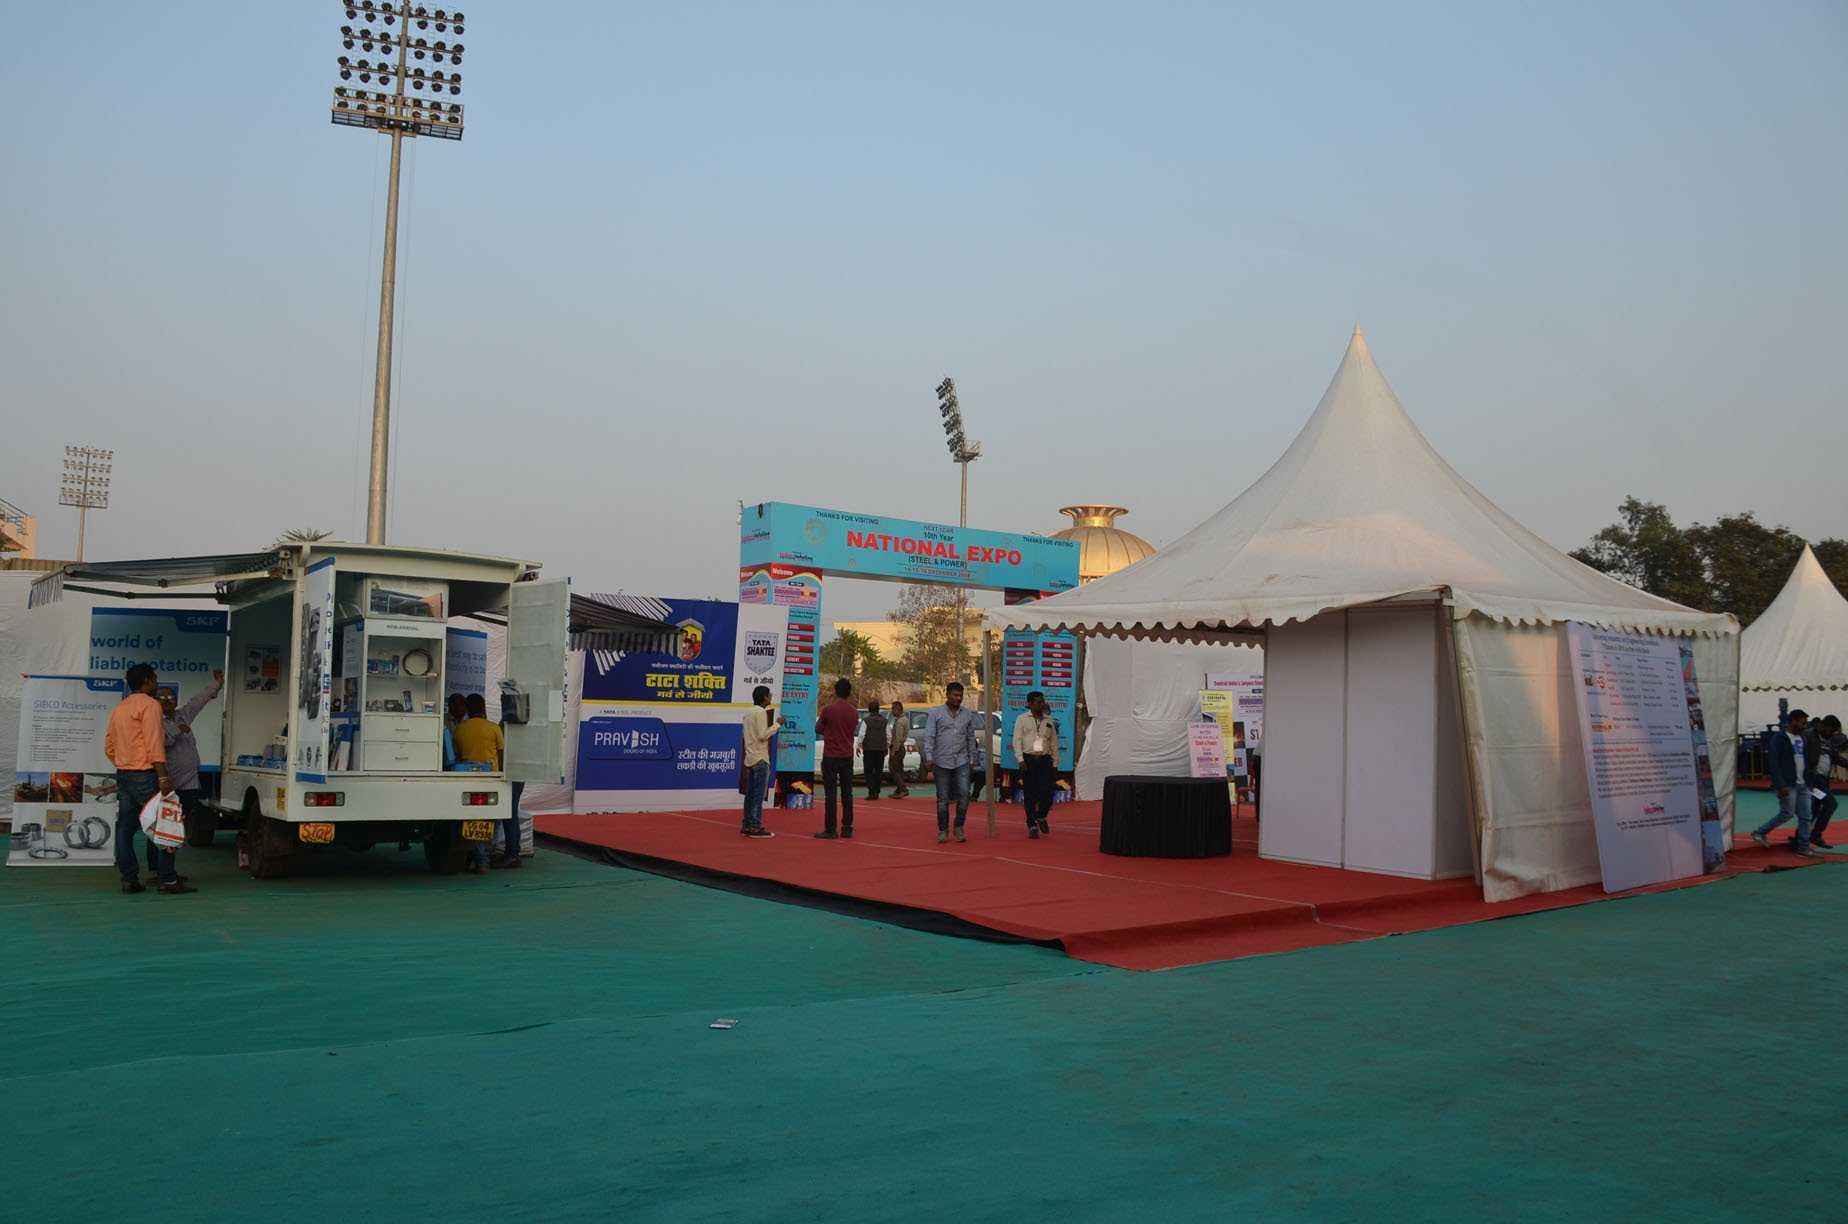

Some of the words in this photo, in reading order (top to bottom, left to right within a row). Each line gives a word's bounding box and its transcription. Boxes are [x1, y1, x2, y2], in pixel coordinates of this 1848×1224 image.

[816, 511, 840, 521] THANKS
[841, 514, 854, 522] FOR
[855, 515, 880, 525] VISITING
[846, 530, 960, 560] NATIONAL
[967, 546, 1022, 566] EXPO
[186, 615, 221, 626] SKF
[91, 634, 141, 648] world
[145, 634, 163, 648] of
[746, 647, 775, 657] SHAKTEE
[645, 673, 680, 688] टाटा
[684, 671, 727, 689] शक्ति
[674, 689, 686, 698] से
[697, 748, 708, 759] की
[697, 760, 707, 770] की
